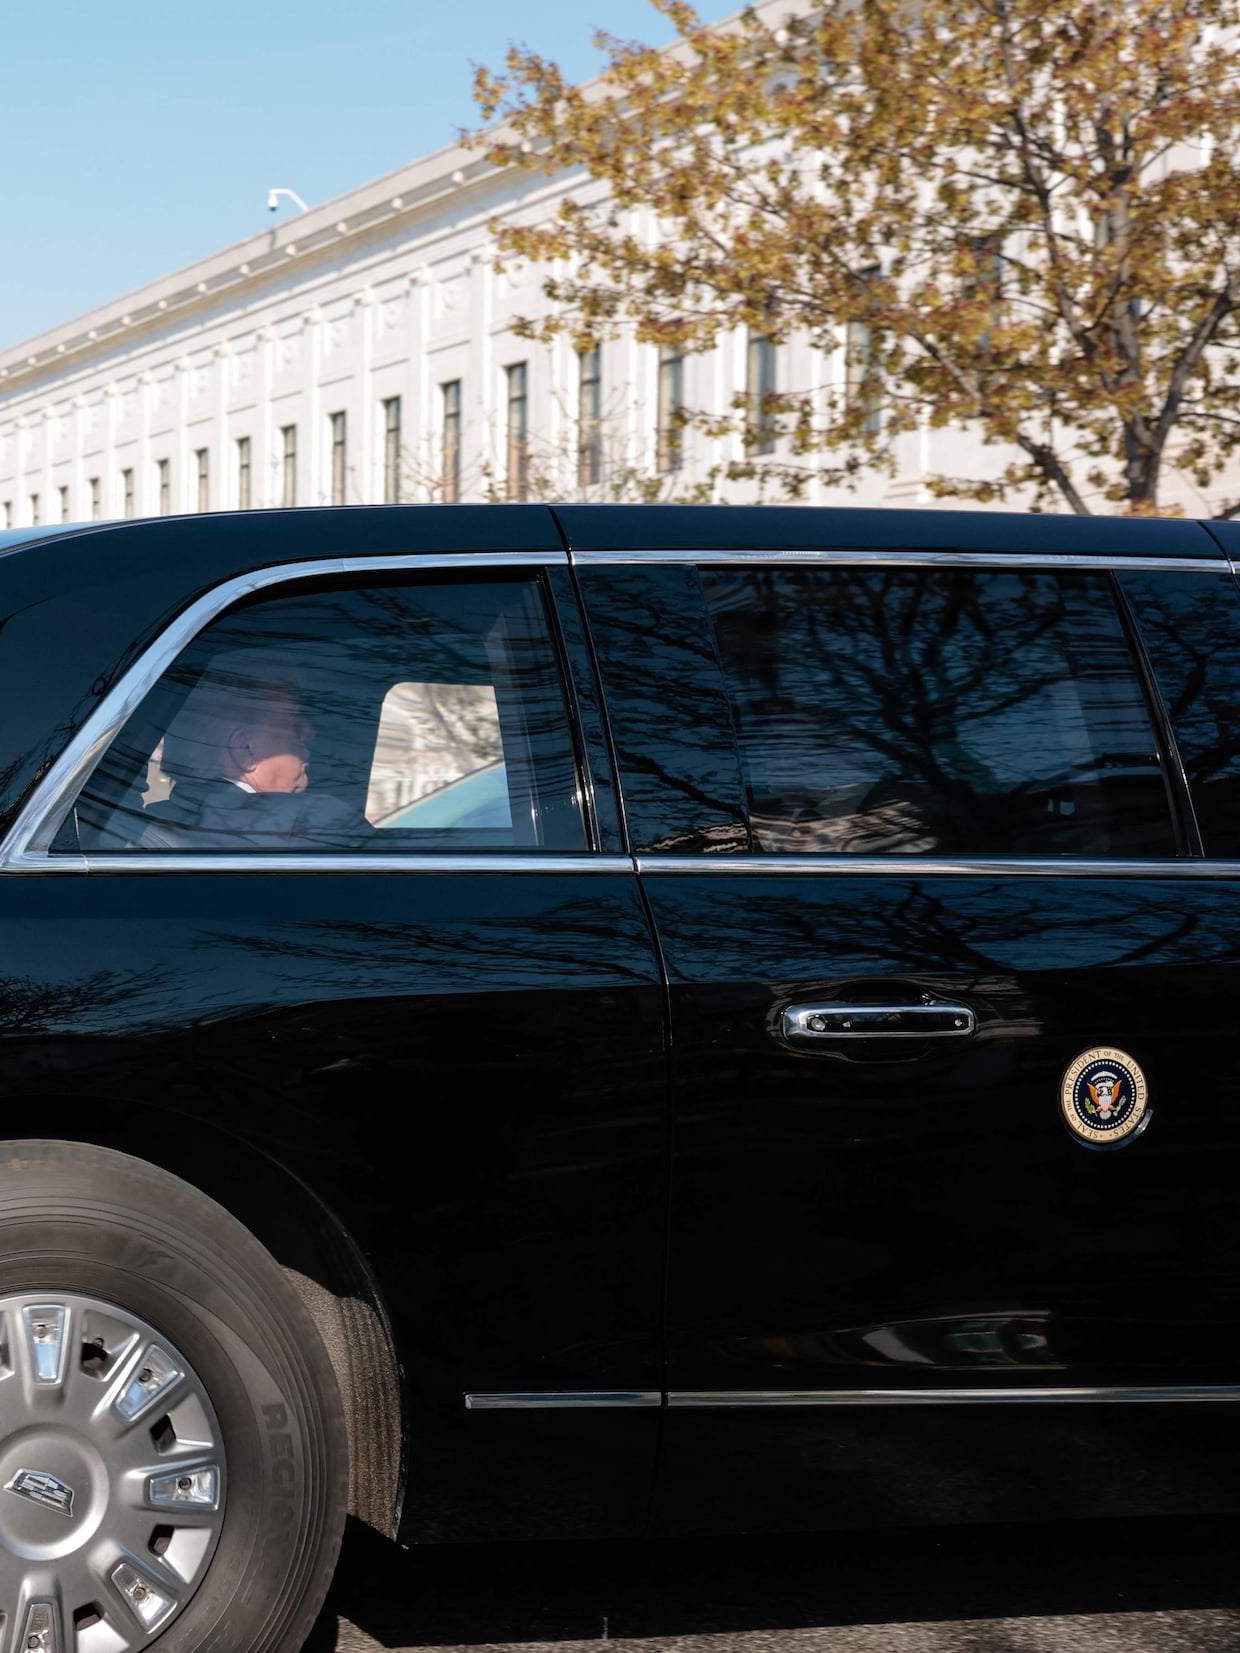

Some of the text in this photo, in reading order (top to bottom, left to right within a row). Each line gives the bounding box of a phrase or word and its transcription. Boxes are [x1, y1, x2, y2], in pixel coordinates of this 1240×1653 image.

[1065, 1051, 1101, 1095] PRESIDENT
[1126, 1061, 1145, 1100] UNITED
[1077, 1121, 1099, 1138] SEAL
[1113, 1106, 1142, 1136] STATES
